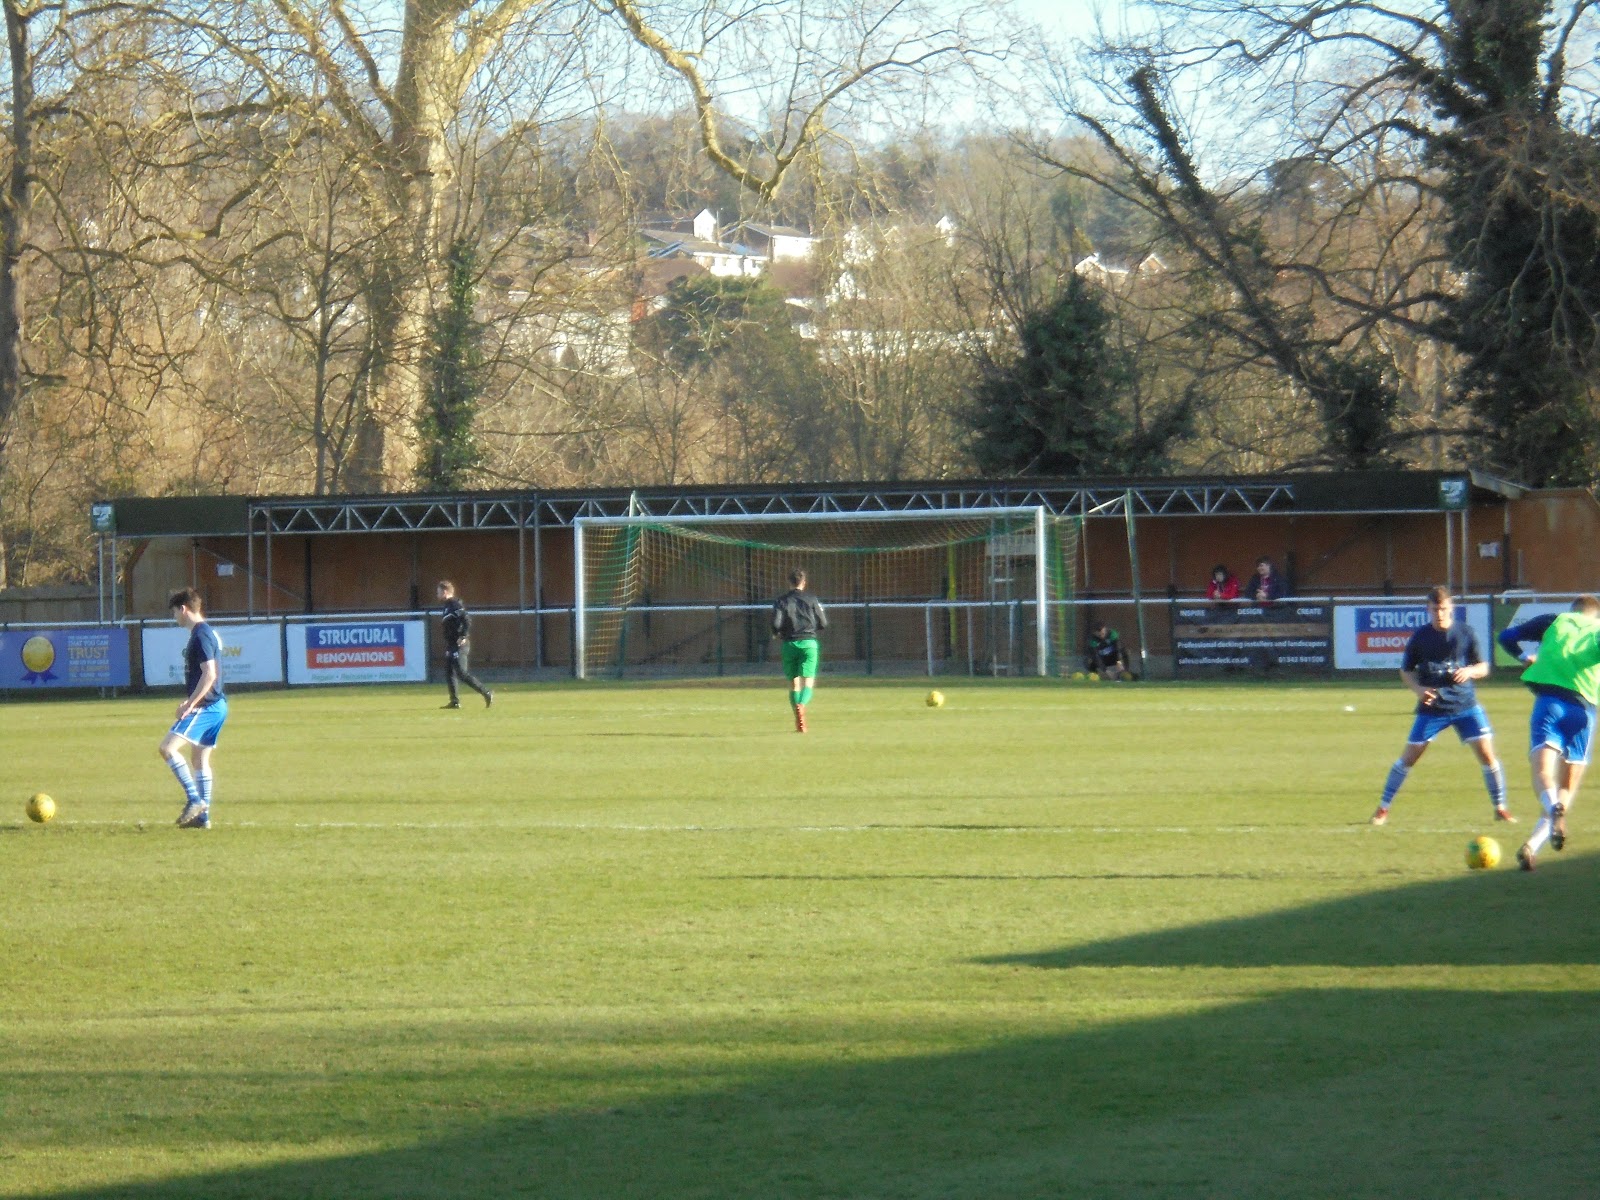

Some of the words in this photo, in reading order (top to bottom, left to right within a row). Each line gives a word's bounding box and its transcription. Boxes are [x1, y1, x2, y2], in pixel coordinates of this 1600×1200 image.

[1180, 609, 1206, 617] INSPIRE
[318, 628, 397, 645] STRUCTURAL
[1367, 636, 1410, 648] RENOV
[1177, 641, 1217, 649] Professional
[1217, 641, 1243, 649] decking
[1287, 640, 1327, 648] landscapers
[67, 646, 109, 660] TRUST
[316, 651, 395, 663] RENOVATIONS
